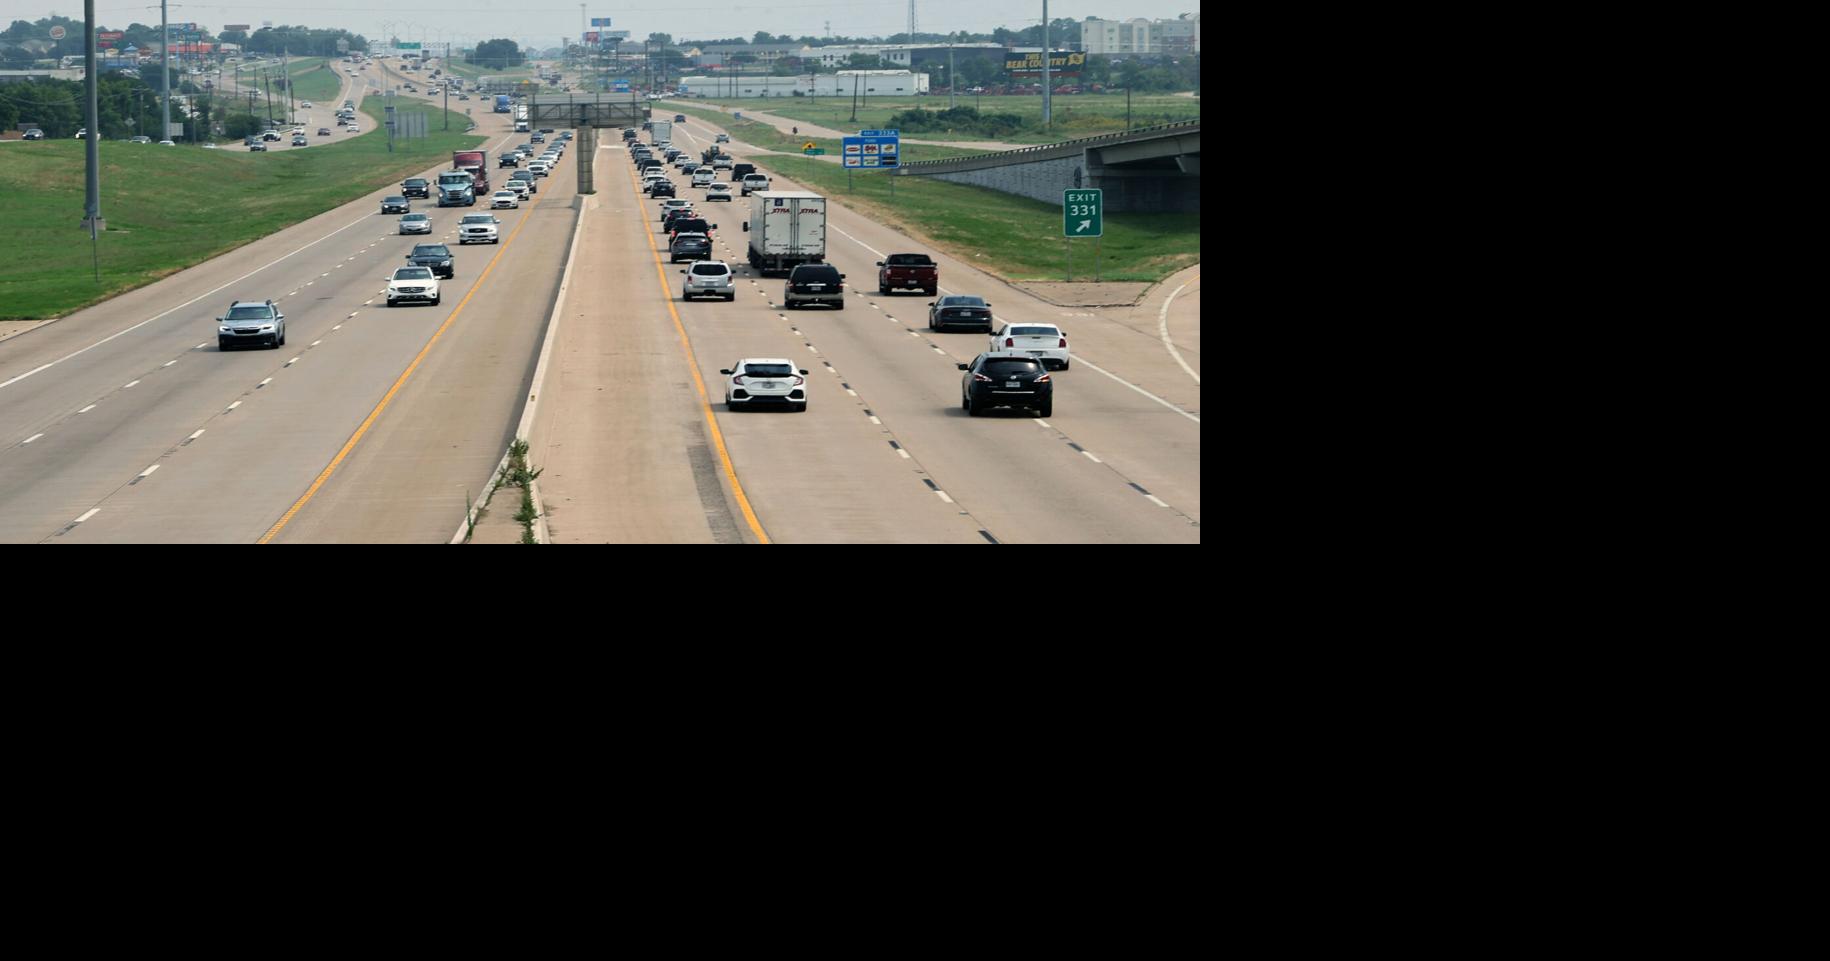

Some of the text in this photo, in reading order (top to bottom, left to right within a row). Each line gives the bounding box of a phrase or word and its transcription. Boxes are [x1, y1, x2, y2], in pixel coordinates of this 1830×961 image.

[1029, 58, 1066, 67] COUTRY
[1068, 193, 1097, 202] EXIT
[1070, 204, 1096, 216] 331
